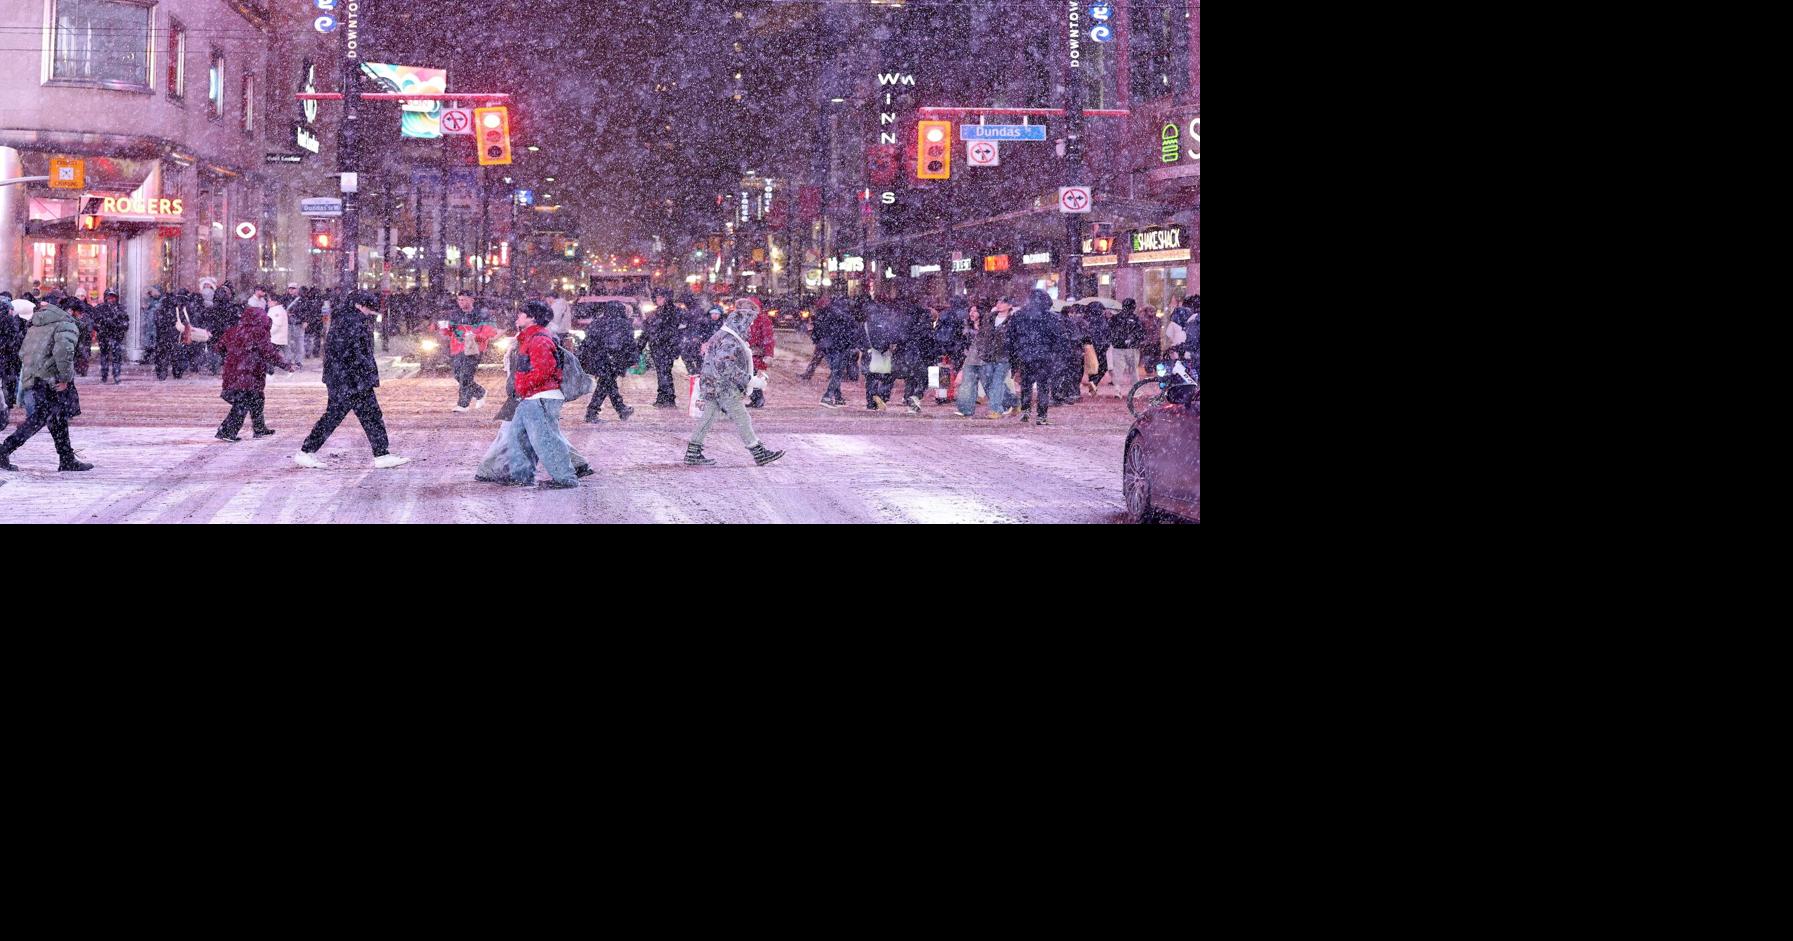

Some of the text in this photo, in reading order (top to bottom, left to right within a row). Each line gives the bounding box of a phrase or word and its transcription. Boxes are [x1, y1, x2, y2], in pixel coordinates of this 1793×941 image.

[347, 0, 358, 58] DOWNTO
[877, 72, 900, 204] WINNS
[975, 126, 1021, 137] Dundas
[103, 196, 183, 215] ROGERS
[1138, 228, 1181, 251] SHAKE SHACK
